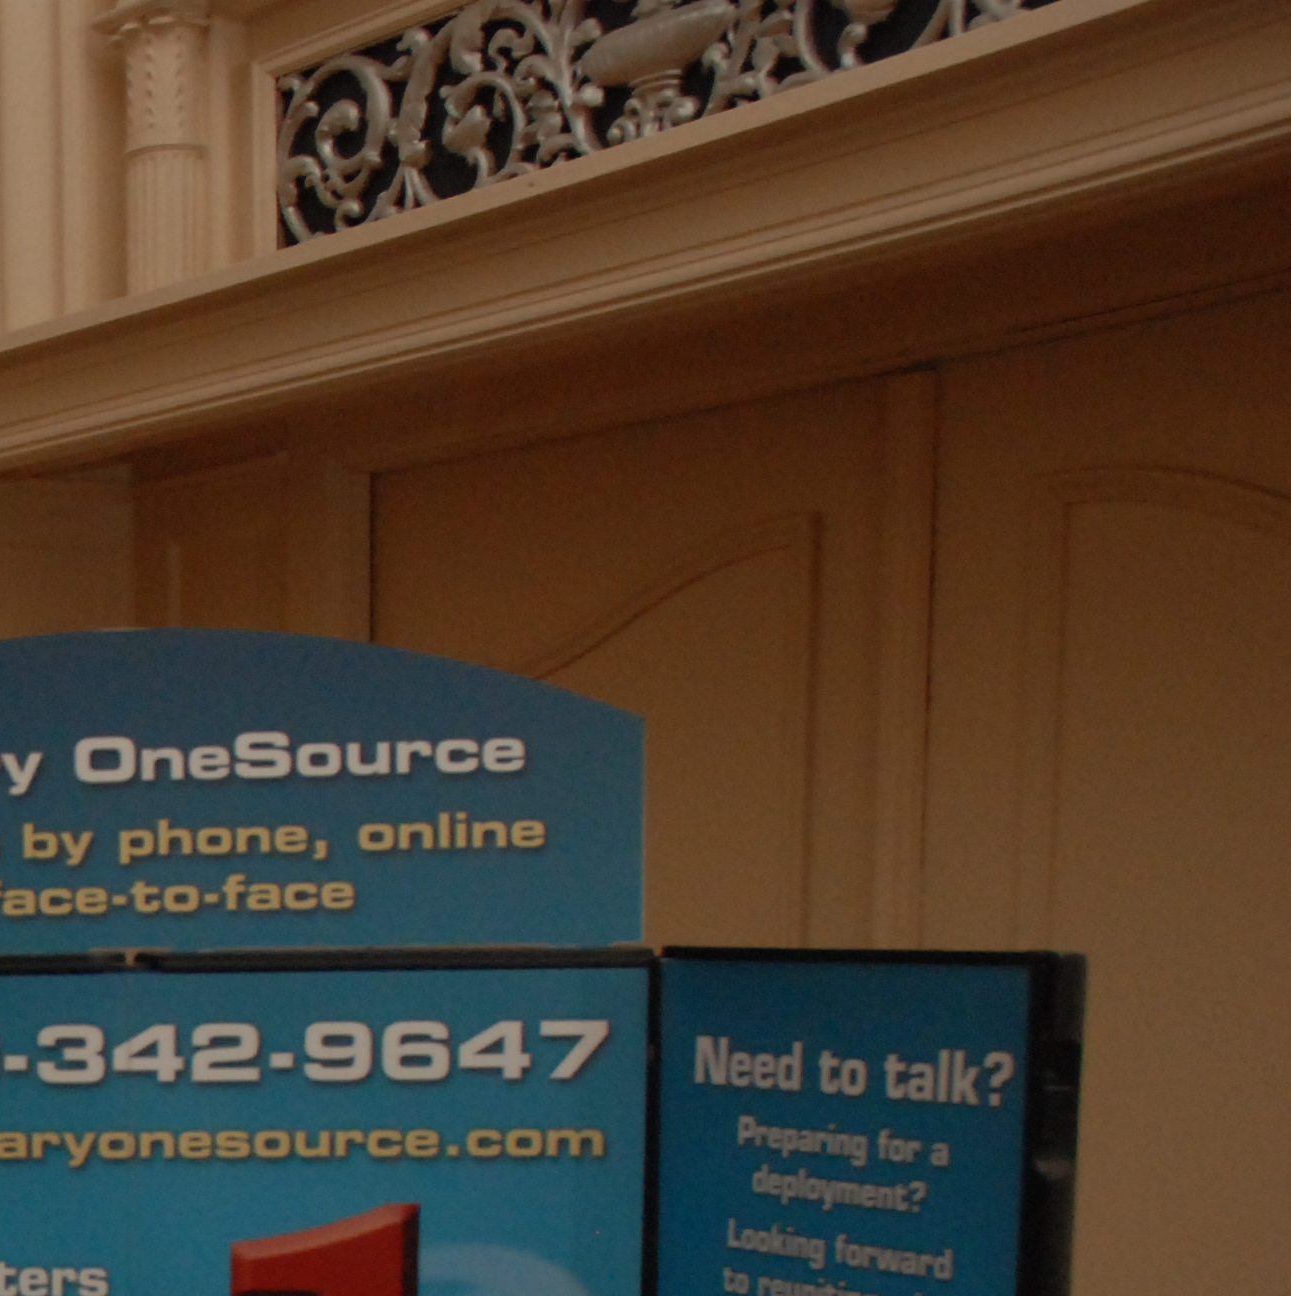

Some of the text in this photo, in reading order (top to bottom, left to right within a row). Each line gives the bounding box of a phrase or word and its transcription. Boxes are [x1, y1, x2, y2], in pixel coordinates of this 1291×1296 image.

[74, 730, 527, 786] OneSource
[22, 822, 93, 866] by
[118, 819, 330, 866] phone,
[357, 811, 546, 854] online
[693, 1034, 1016, 1108] Need to talk?
[736, 1114, 950, 1169] Preparing for a
[752, 1163, 928, 1213] deployment?
[726, 1216, 954, 1281] Looking forward
[723, 1266, 750, 1295] to
